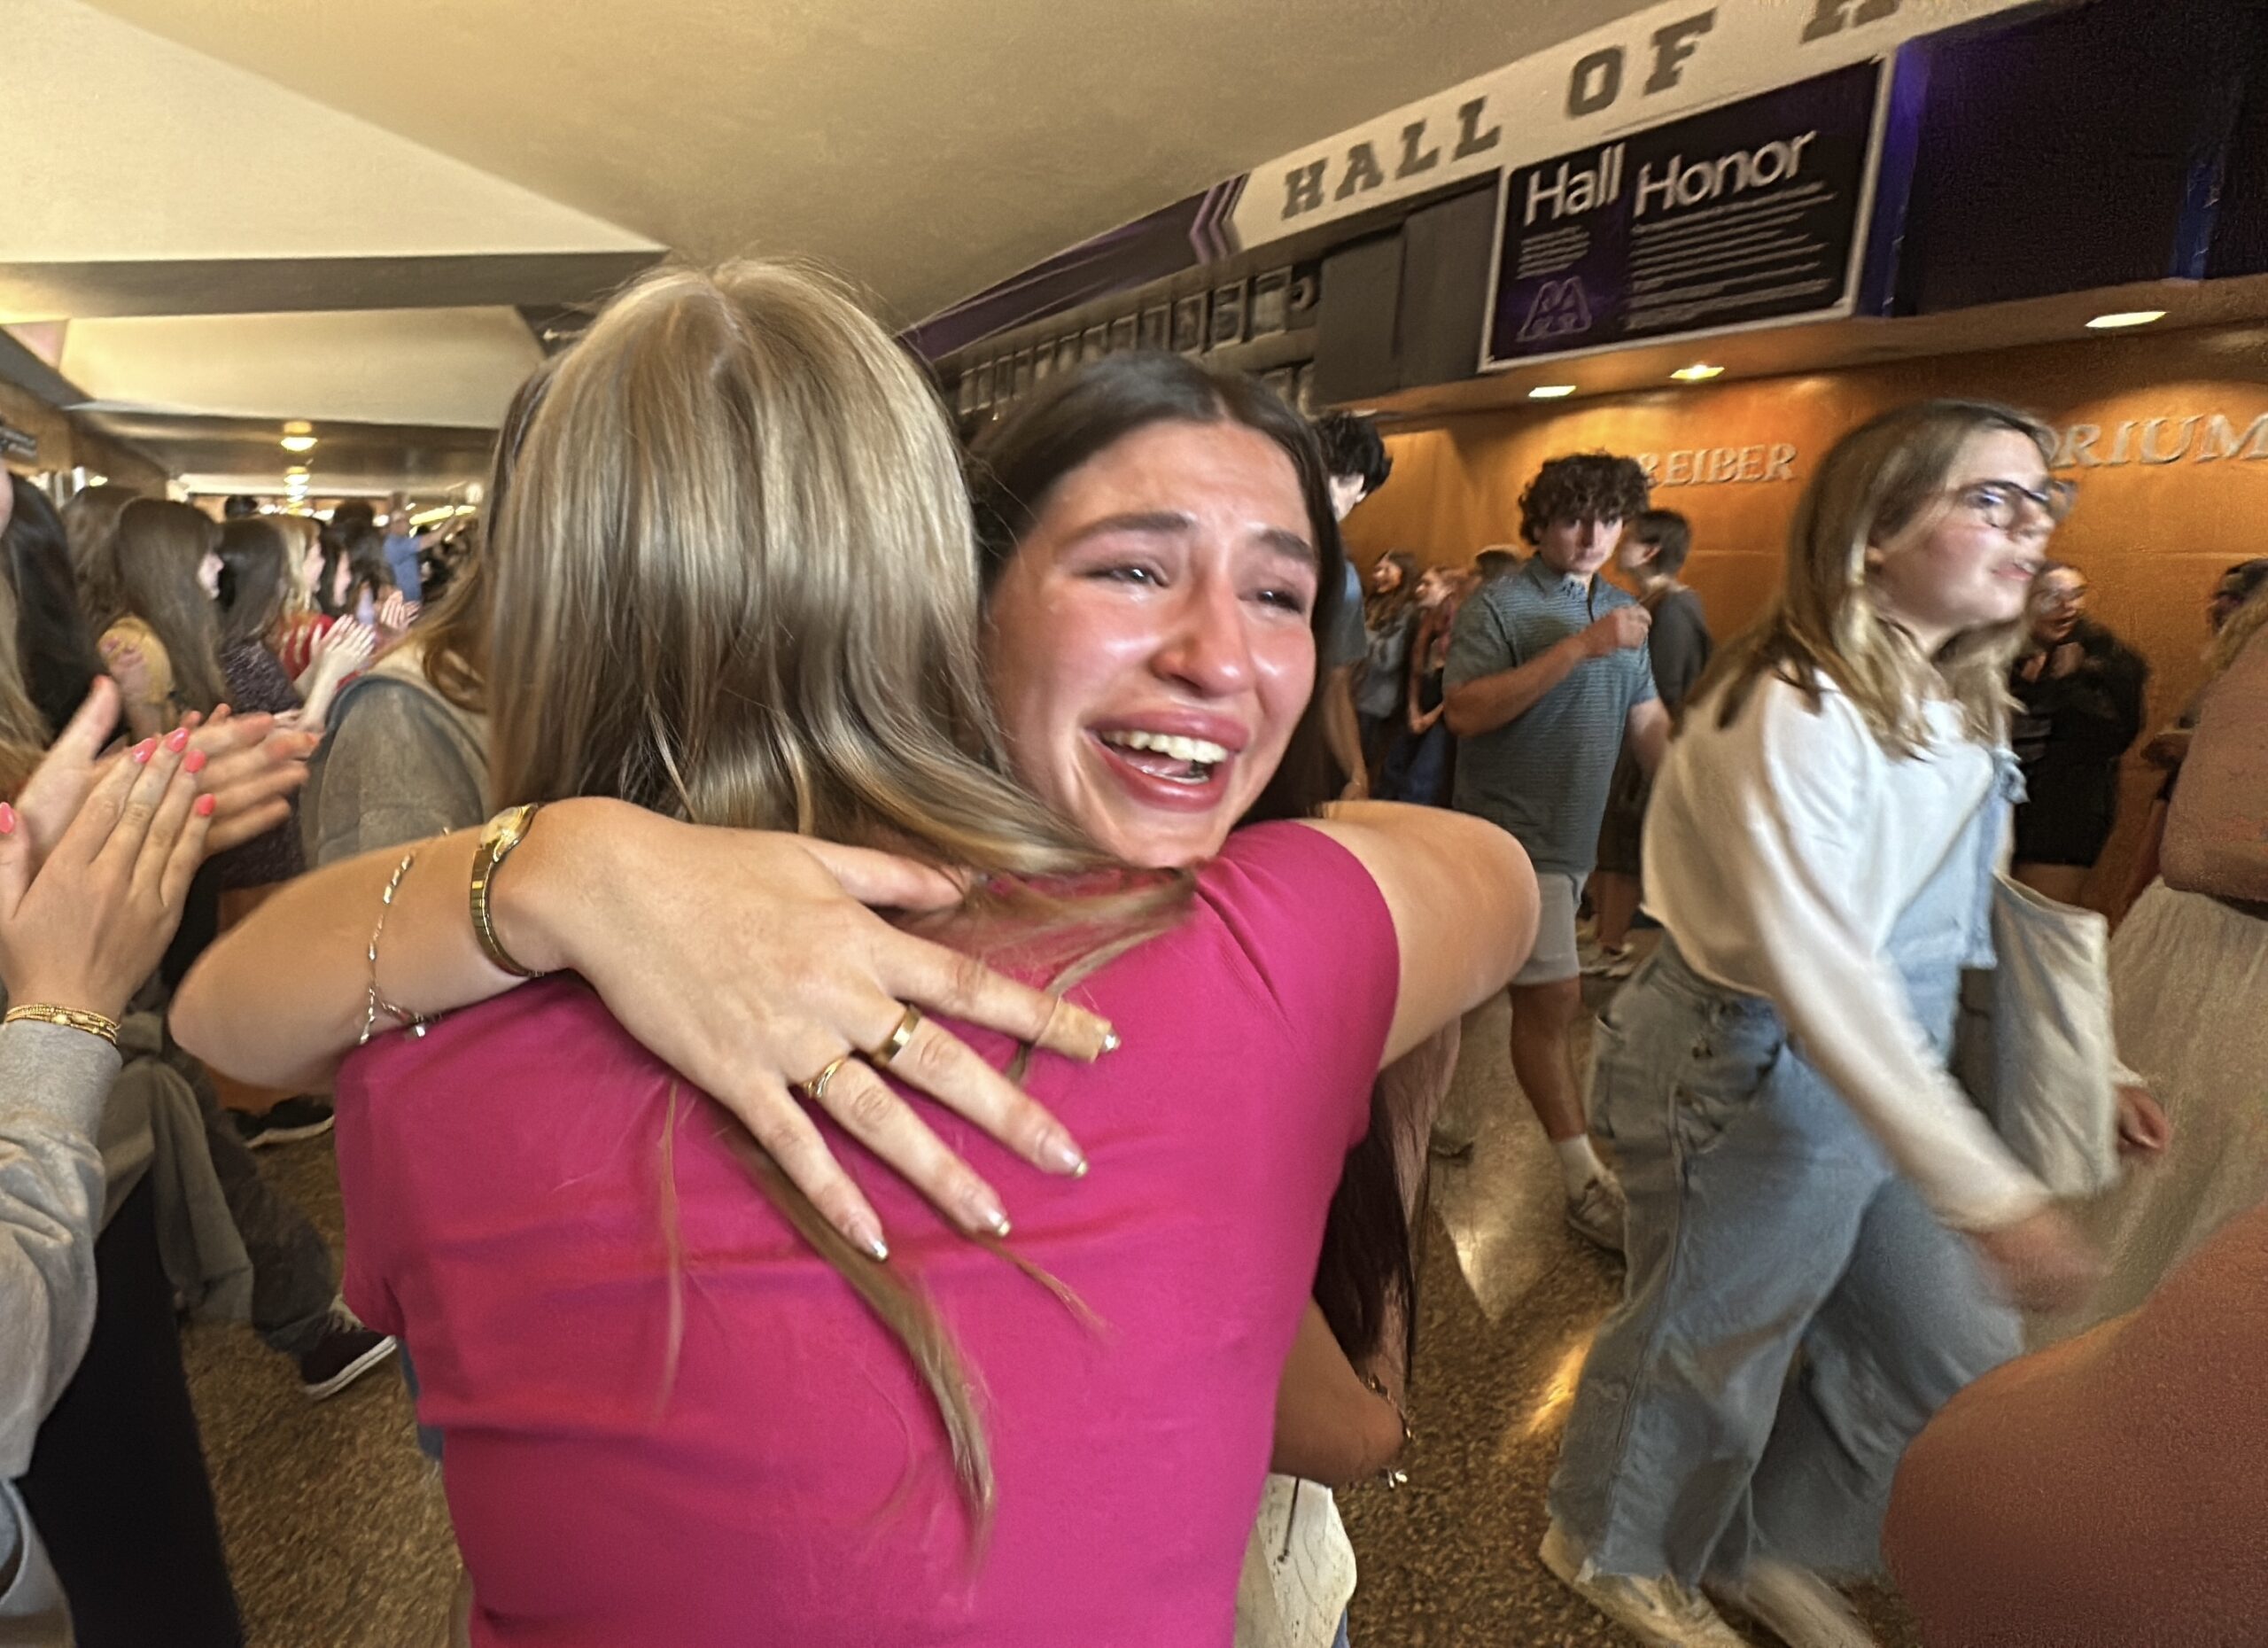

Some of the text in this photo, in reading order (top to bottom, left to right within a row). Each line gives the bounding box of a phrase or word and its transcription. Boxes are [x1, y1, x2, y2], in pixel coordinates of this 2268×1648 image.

[1281, 7, 1717, 221] HALL OF
[1524, 130, 1816, 227] Hall Honor
